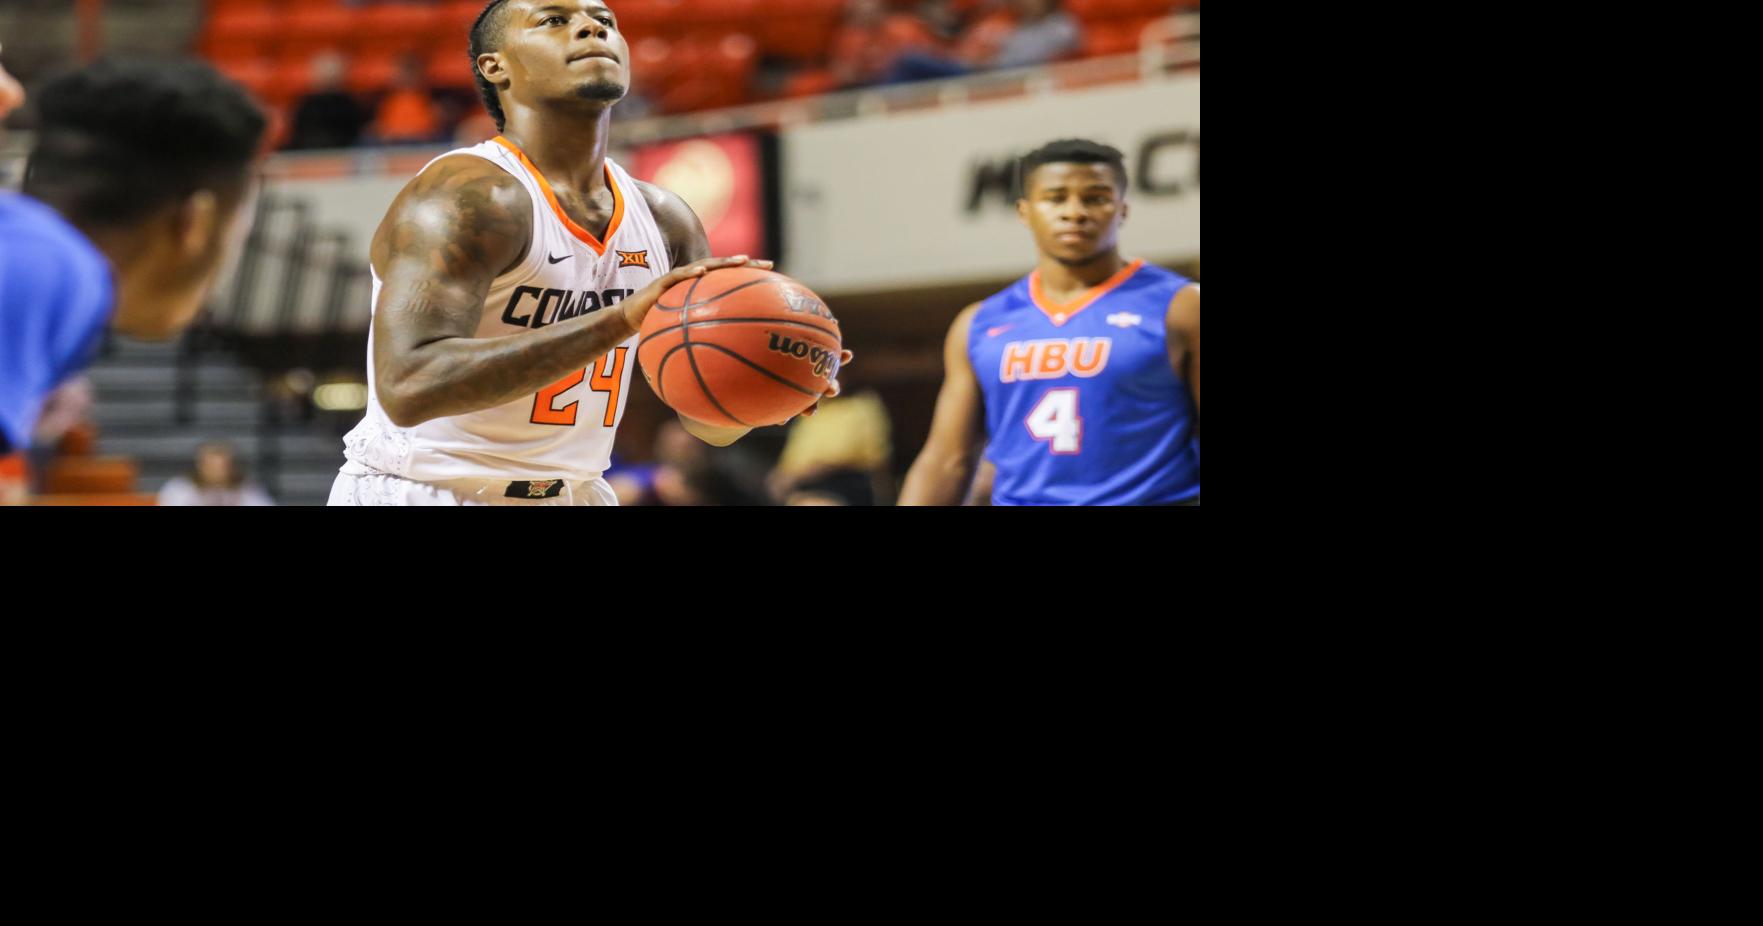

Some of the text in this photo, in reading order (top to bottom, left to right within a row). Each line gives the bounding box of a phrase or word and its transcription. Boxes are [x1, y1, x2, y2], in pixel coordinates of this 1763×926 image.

[620, 251, 648, 267] XII
[530, 346, 629, 427] 24
[1001, 337, 1112, 383] HBU
[1025, 387, 1083, 454] 4
